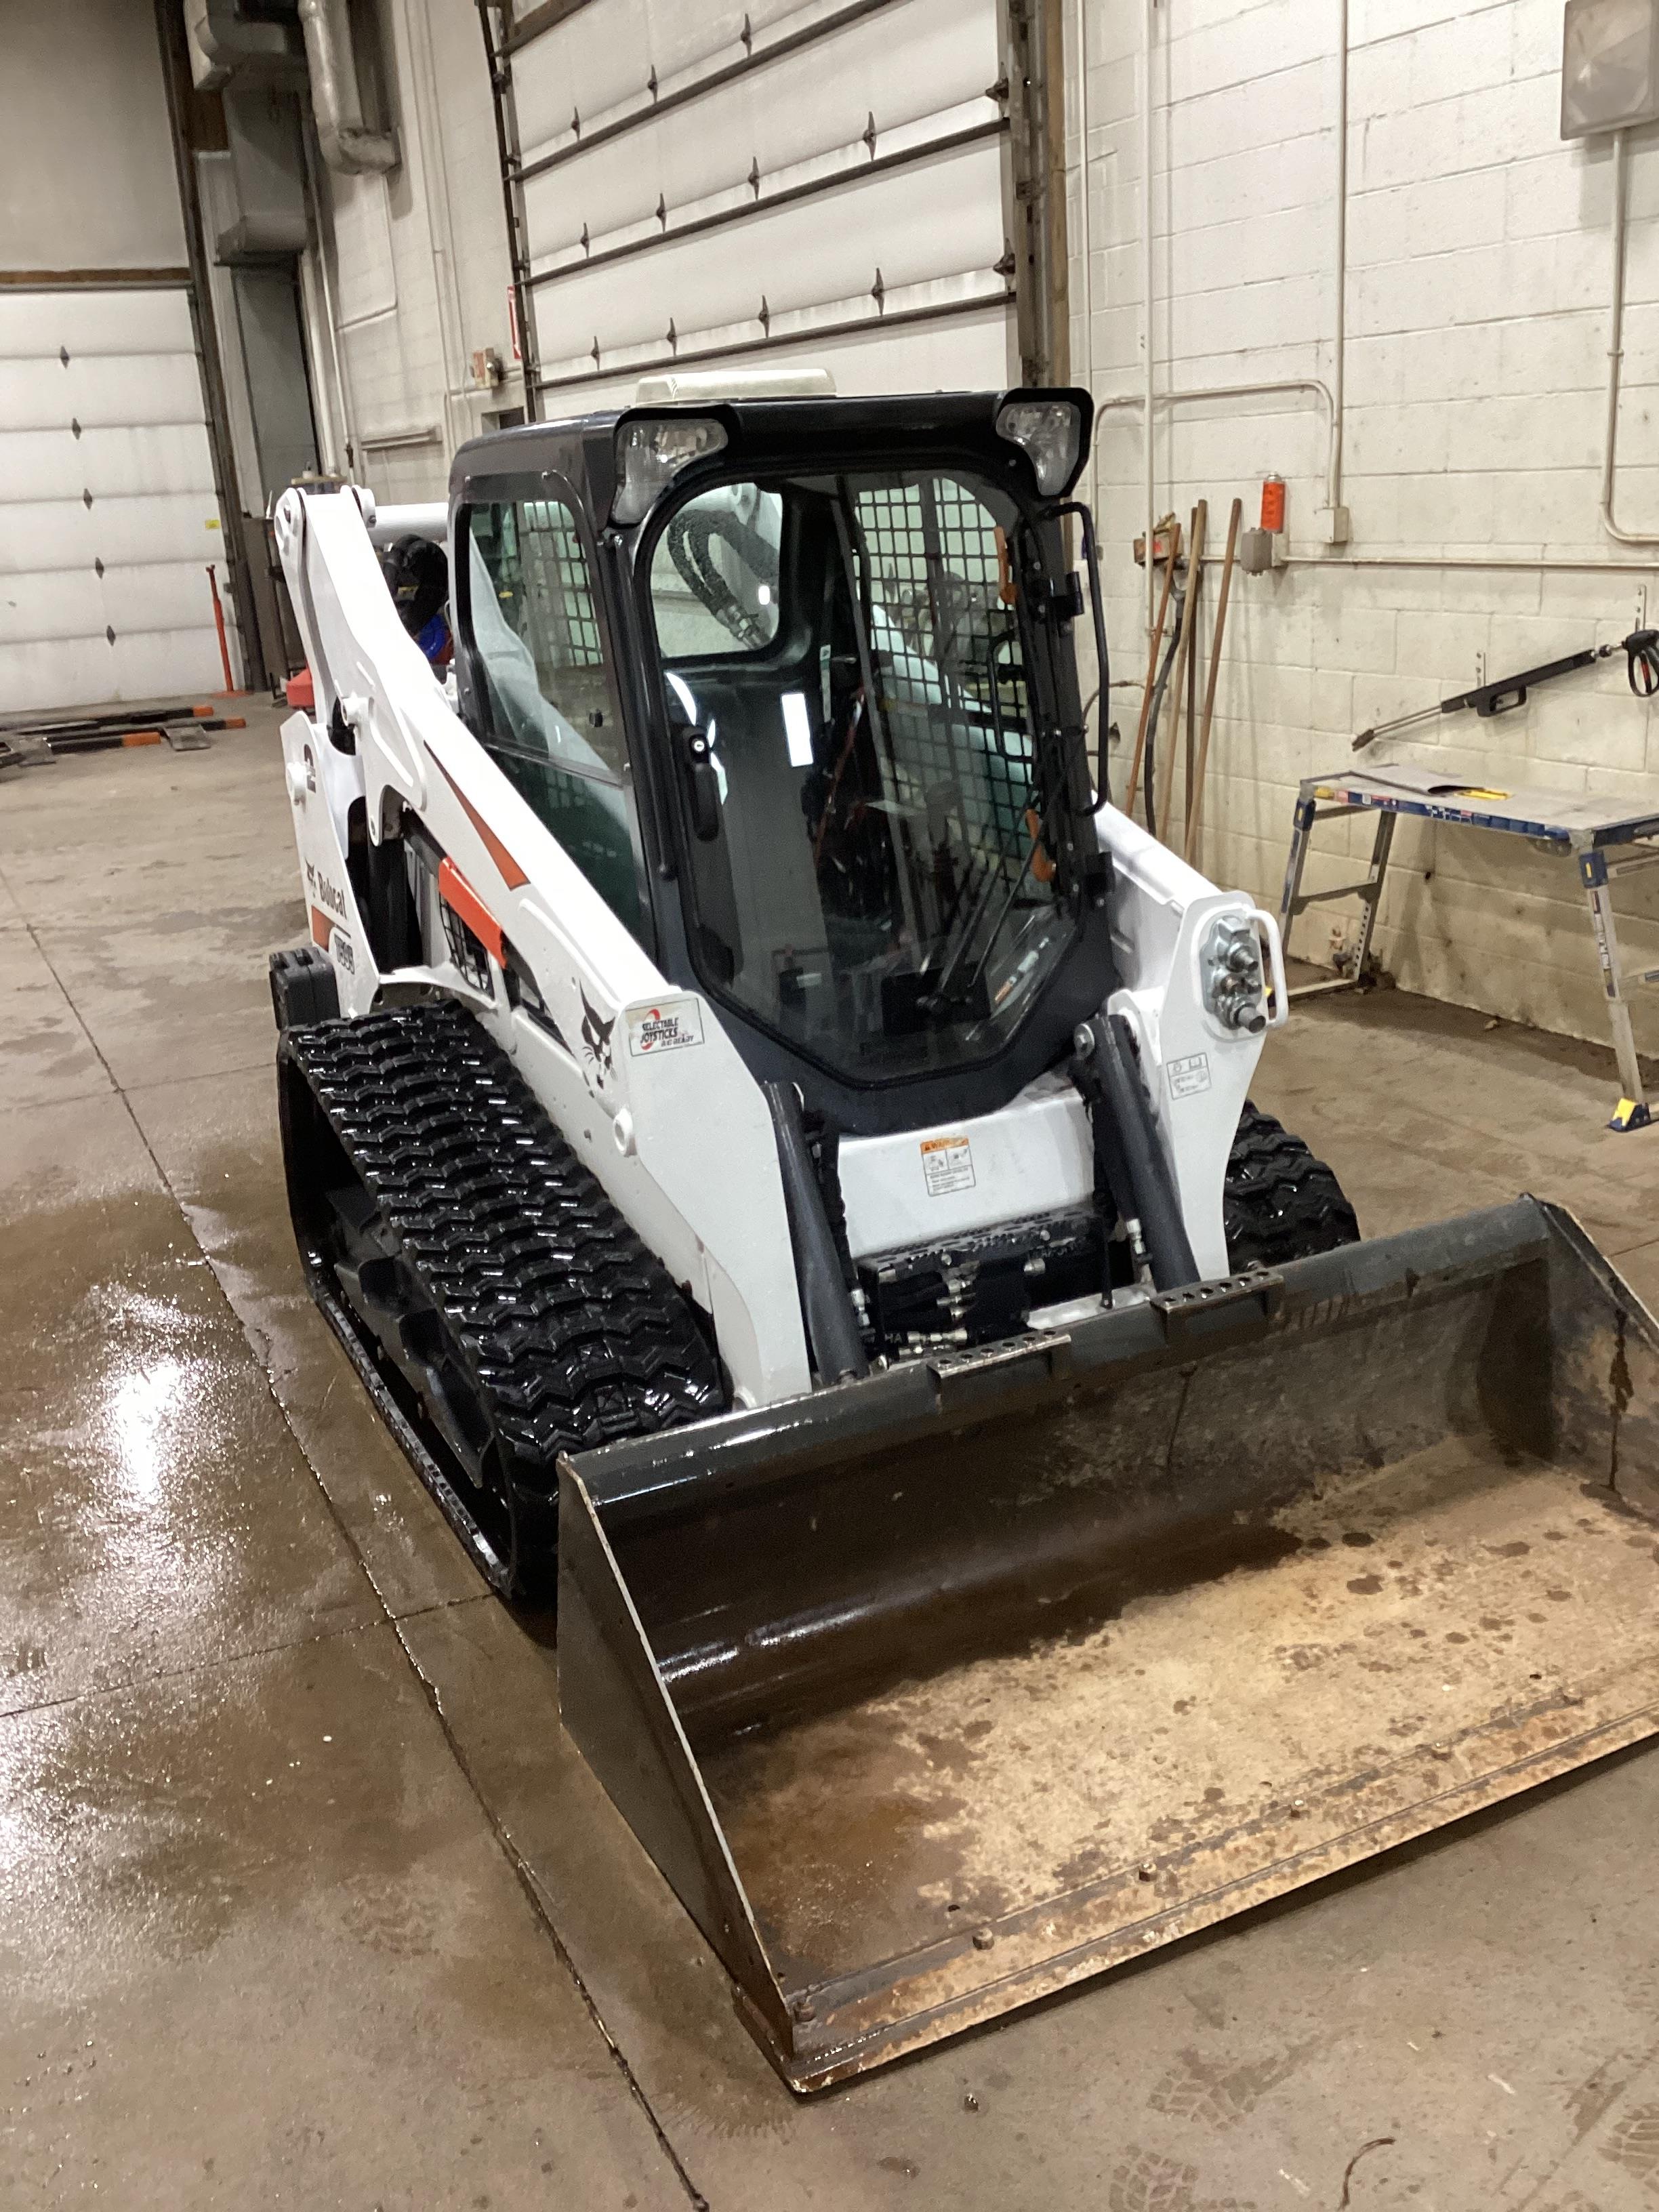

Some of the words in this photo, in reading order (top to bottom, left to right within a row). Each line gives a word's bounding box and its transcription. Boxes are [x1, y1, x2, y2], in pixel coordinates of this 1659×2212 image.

[317, 871, 347, 920] Bobcat
[642, 1017, 679, 1031] SELECTABLE
[640, 1027, 678, 1044] JOYSTICKS
